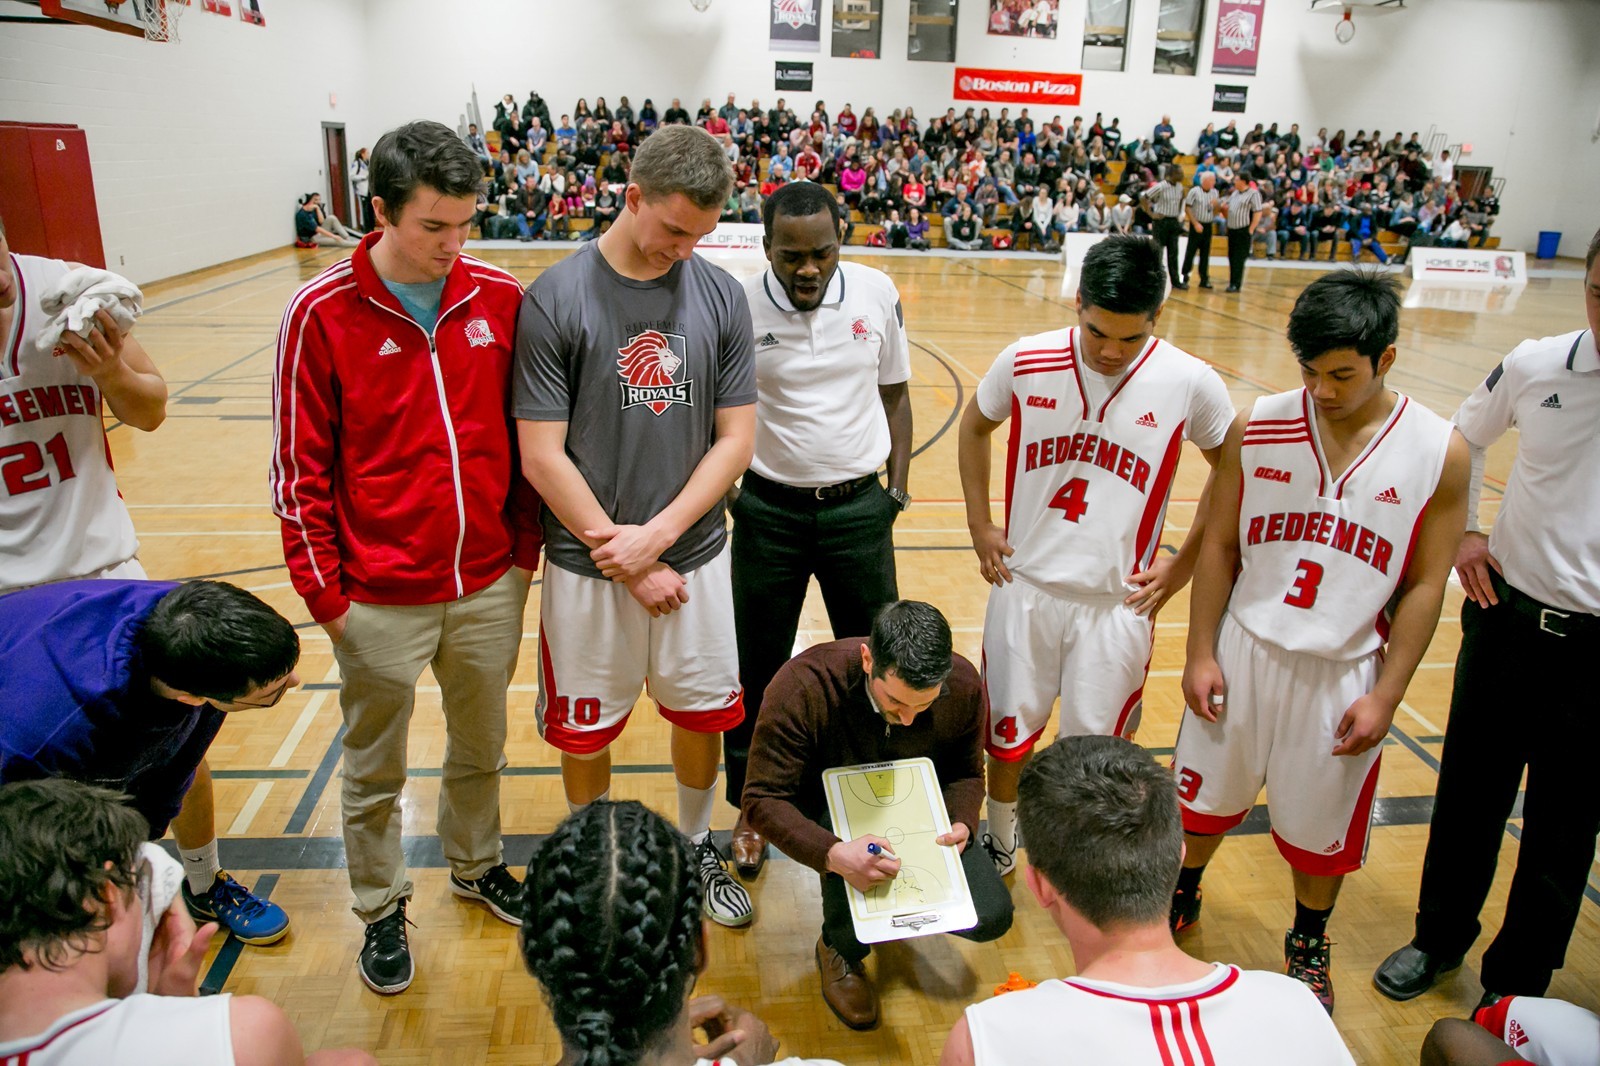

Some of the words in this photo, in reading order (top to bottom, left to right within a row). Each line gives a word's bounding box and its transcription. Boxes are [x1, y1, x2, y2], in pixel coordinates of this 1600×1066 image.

[972, 77, 1030, 93] Boston
[1031, 80, 1076, 96] Pizza
[718, 234, 733, 243] OF
[738, 235, 760, 244] THE
[1425, 259, 1452, 267] HOME
[1456, 260, 1468, 268] OF
[1473, 261, 1490, 269] THE
[624, 320, 686, 334] REDEEMER
[628, 385, 686, 404] ROYALS
[1026, 395, 1057, 410] OCAA
[1135, 419, 1158, 428] adidas
[0, 431, 77, 496] 21
[1025, 432, 1151, 496] REDEEMER
[1253, 466, 1292, 484] OCAA
[1047, 476, 1090, 524] 4
[1374, 495, 1401, 505] adidas
[1247, 511, 1394, 577] REDEEMER
[1283, 558, 1325, 610] 3
[994, 715, 1018, 744] 4
[1177, 766, 1203, 803] 3
[1509, 1019, 1517, 1047] adida
